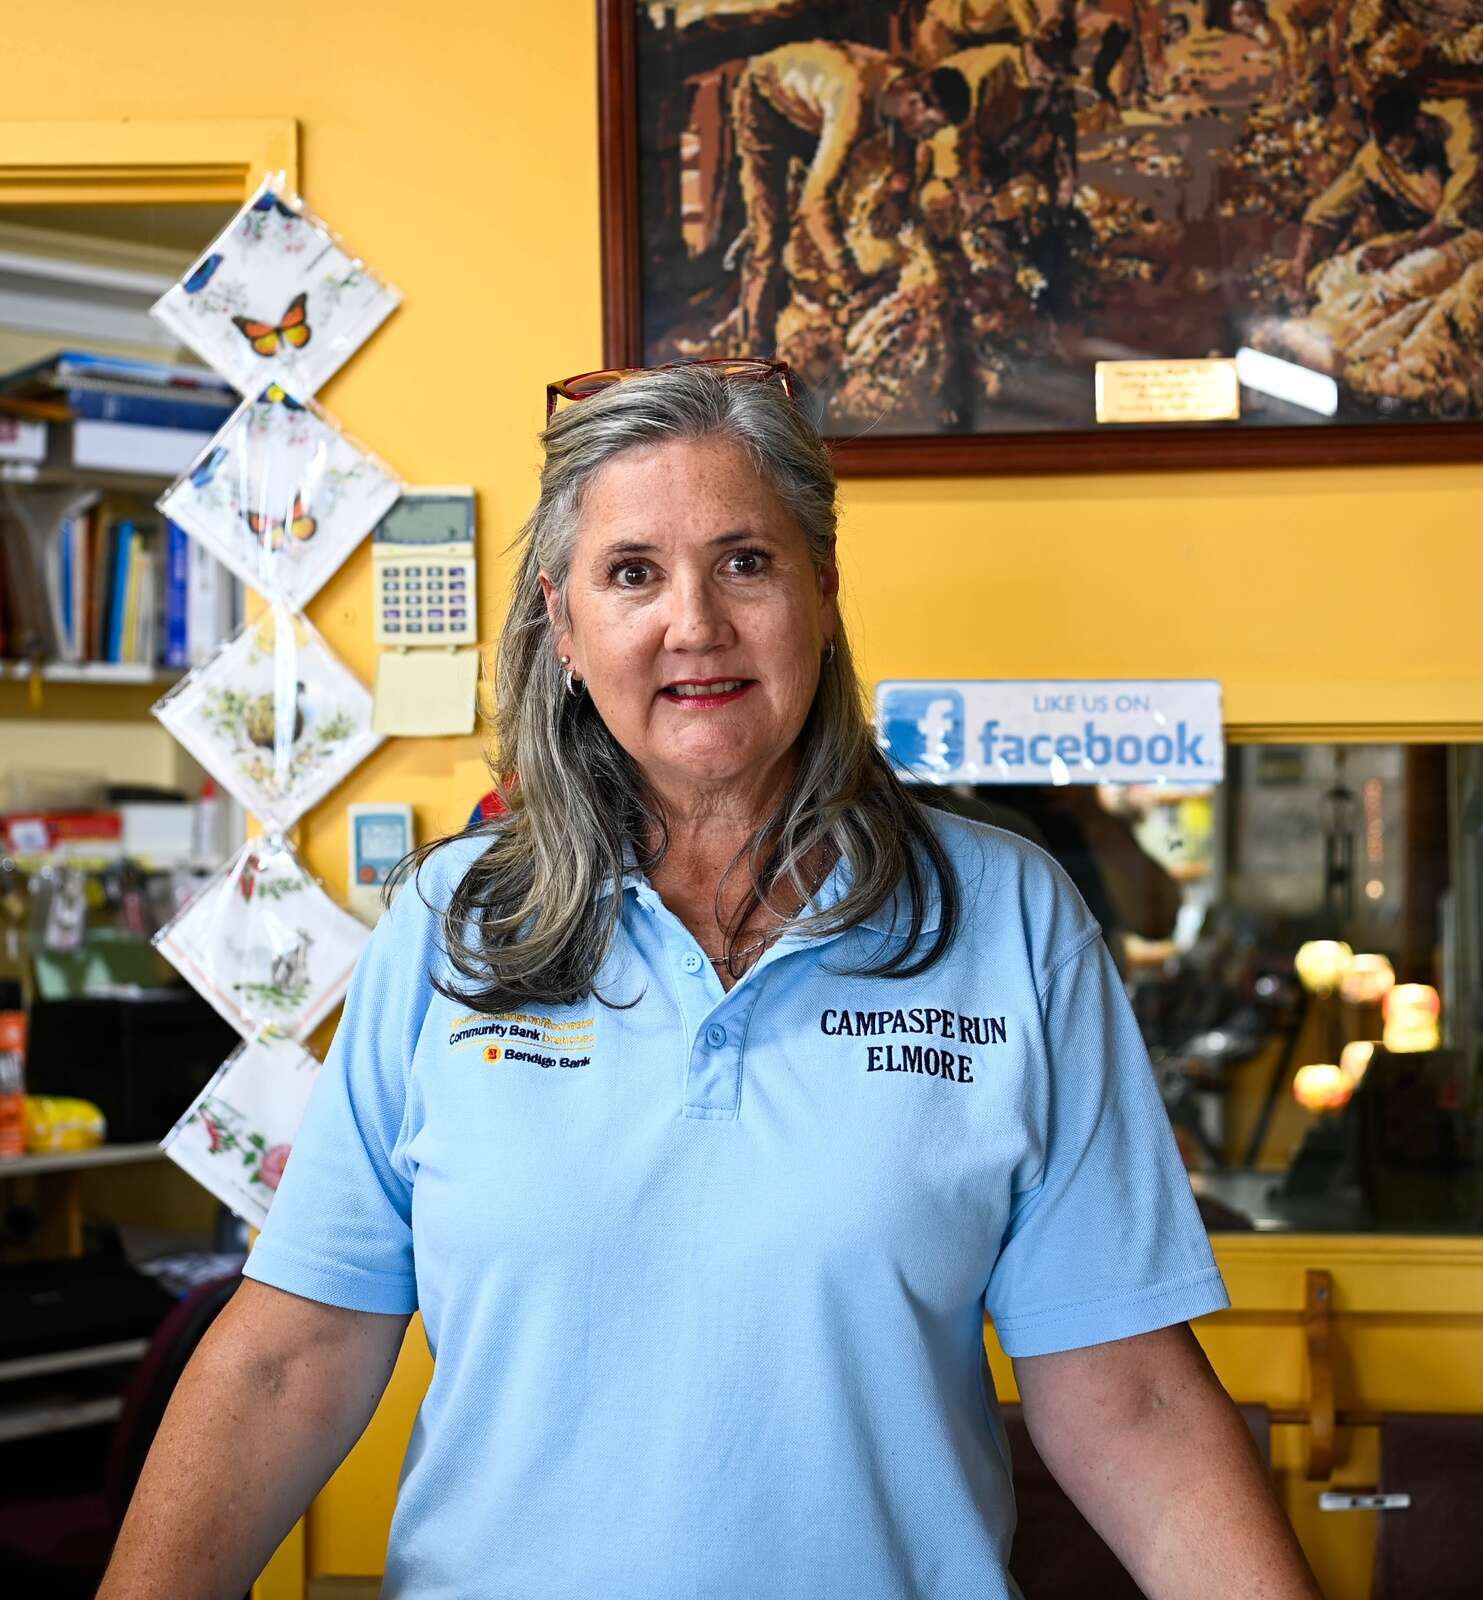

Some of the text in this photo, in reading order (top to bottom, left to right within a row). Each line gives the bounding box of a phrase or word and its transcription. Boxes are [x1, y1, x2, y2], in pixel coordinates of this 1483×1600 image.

[1033, 694, 1150, 713] LIKE US ON
[978, 720, 1205, 766] facebook
[449, 1023, 508, 1046] Community
[509, 1024, 541, 1042] Bank
[820, 1008, 1007, 1045] CAMPASPE RUN
[504, 1048, 591, 1069] Bendigo Bank
[866, 1045, 974, 1083] ELMORE
